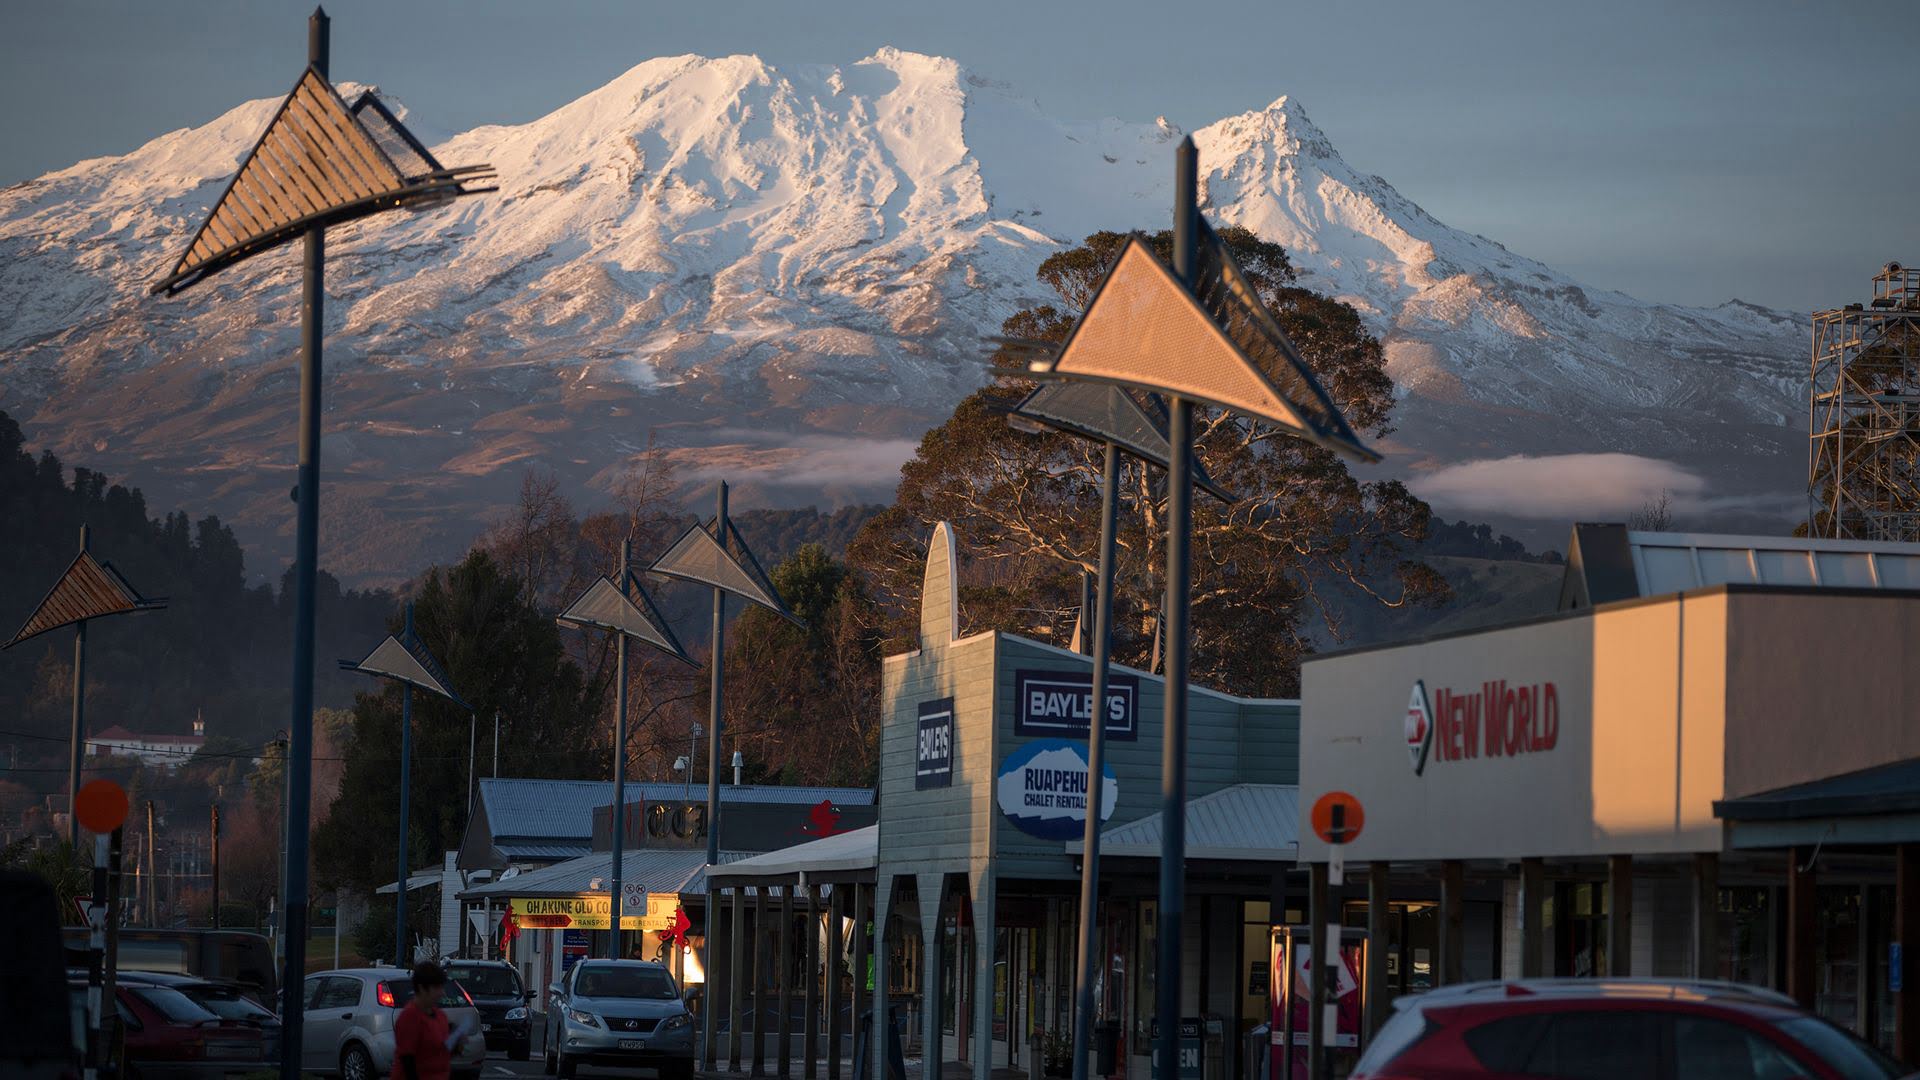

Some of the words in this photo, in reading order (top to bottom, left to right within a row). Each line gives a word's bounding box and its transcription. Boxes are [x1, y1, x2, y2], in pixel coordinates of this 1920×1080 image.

[1030, 691, 1125, 720] BAYLES
[1435, 687, 1481, 762] NEW
[1483, 679, 1559, 757] WORLD
[920, 725, 949, 761] BAYLEYS
[1025, 768, 1088, 793] RUAPEHU
[1024, 793, 1054, 807] CHALET
[526, 901, 573, 914] OHAKUNE
[574, 901, 593, 914] OLD
[574, 919, 610, 927] TRANSPOR
[621, 919, 637, 927] BIKE
[638, 919, 668, 927] RENTALS
[1152, 1048, 1199, 1068] OEN
